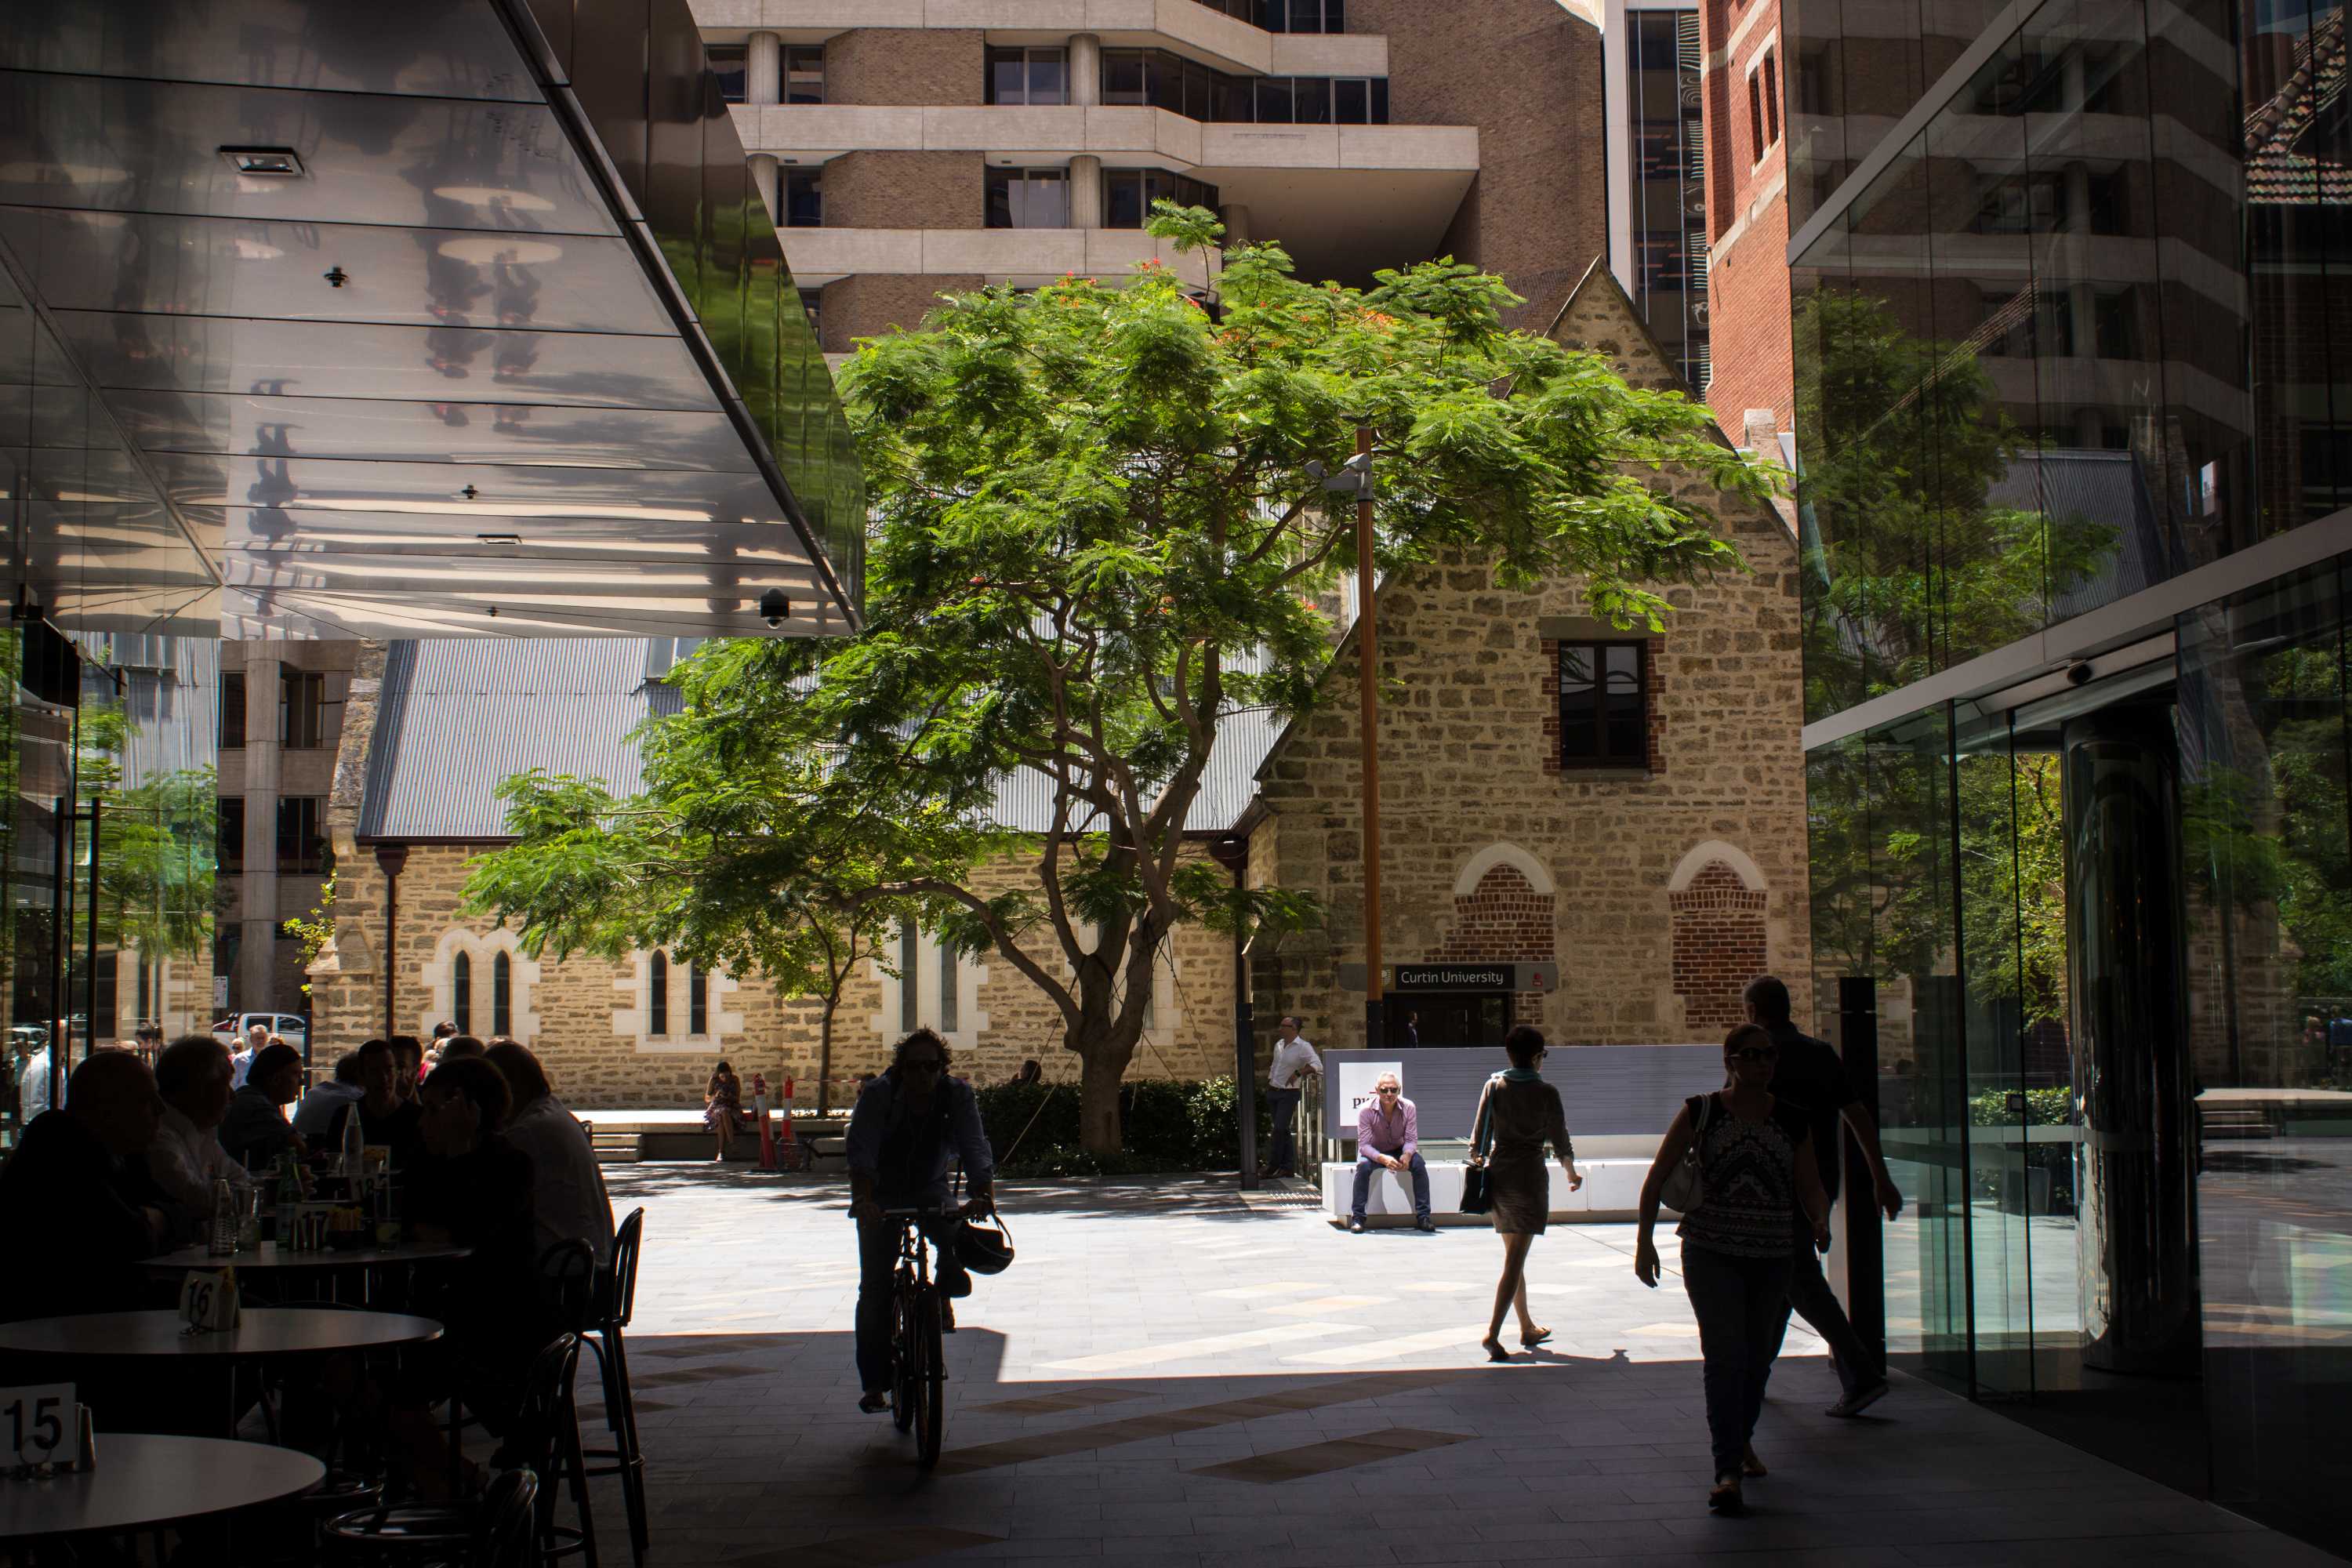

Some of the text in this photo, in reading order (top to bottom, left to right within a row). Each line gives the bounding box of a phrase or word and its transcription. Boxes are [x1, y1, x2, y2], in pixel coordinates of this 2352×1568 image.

[1400, 971, 1504, 985] Curtin University
[190, 1279, 212, 1316] 16
[4, 1397, 62, 1451] 15
